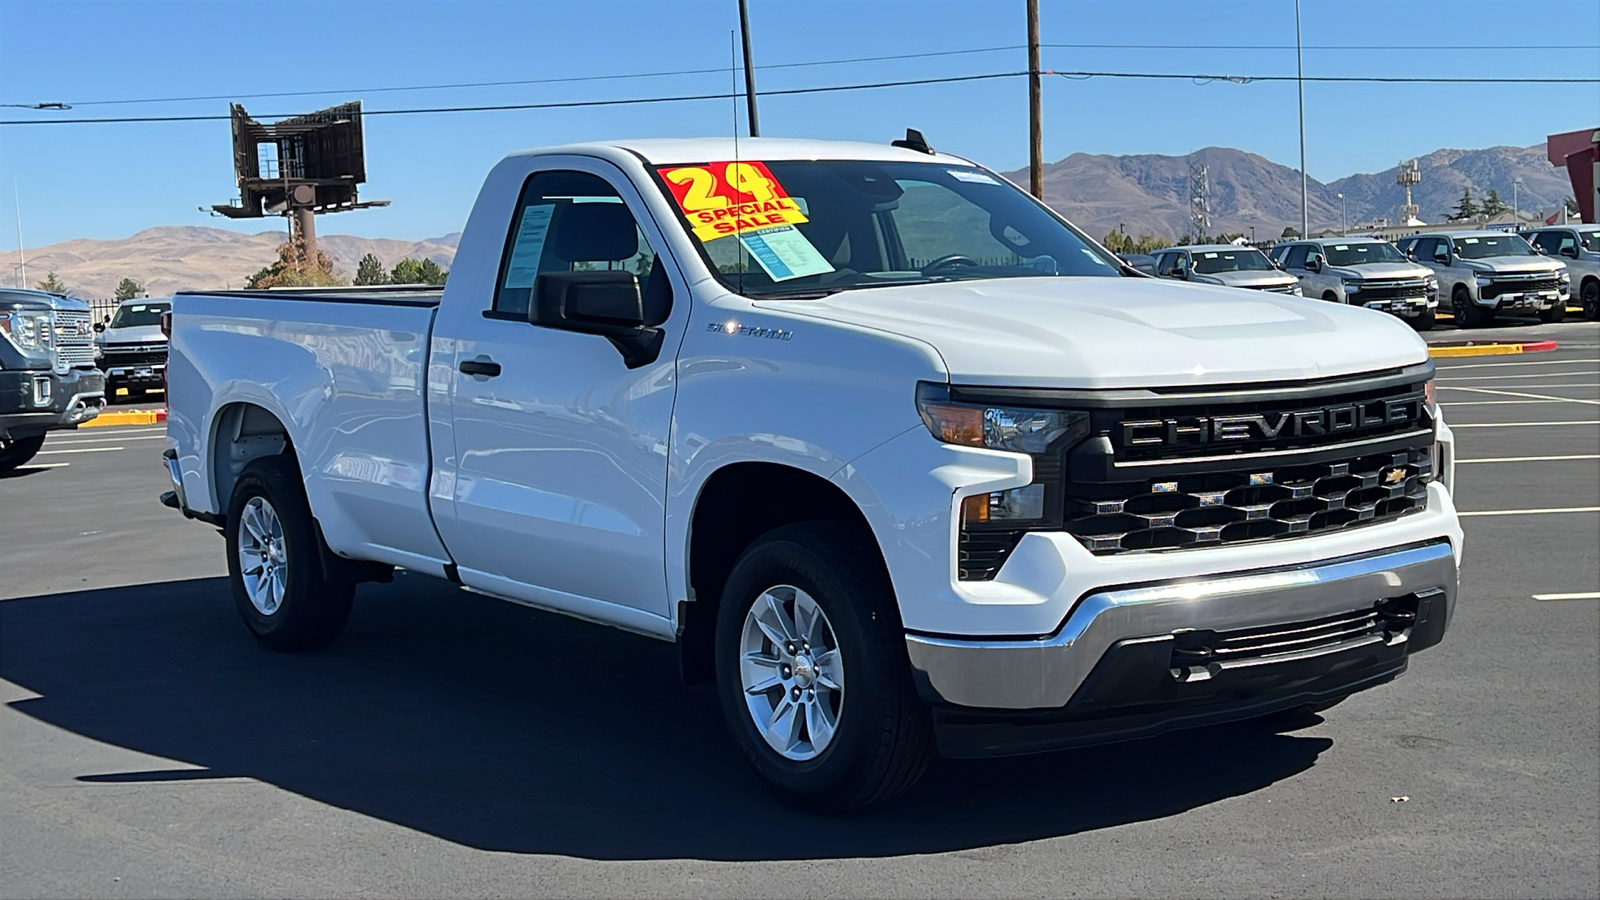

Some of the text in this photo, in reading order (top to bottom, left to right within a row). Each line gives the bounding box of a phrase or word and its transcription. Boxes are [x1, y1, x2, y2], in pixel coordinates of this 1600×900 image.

[666, 163, 776, 210] 24
[698, 200, 791, 223] SPECIAL
[713, 213, 786, 234] SALE
[706, 322, 793, 341] SILERADO
[1122, 394, 1423, 446] CHEVROLET
